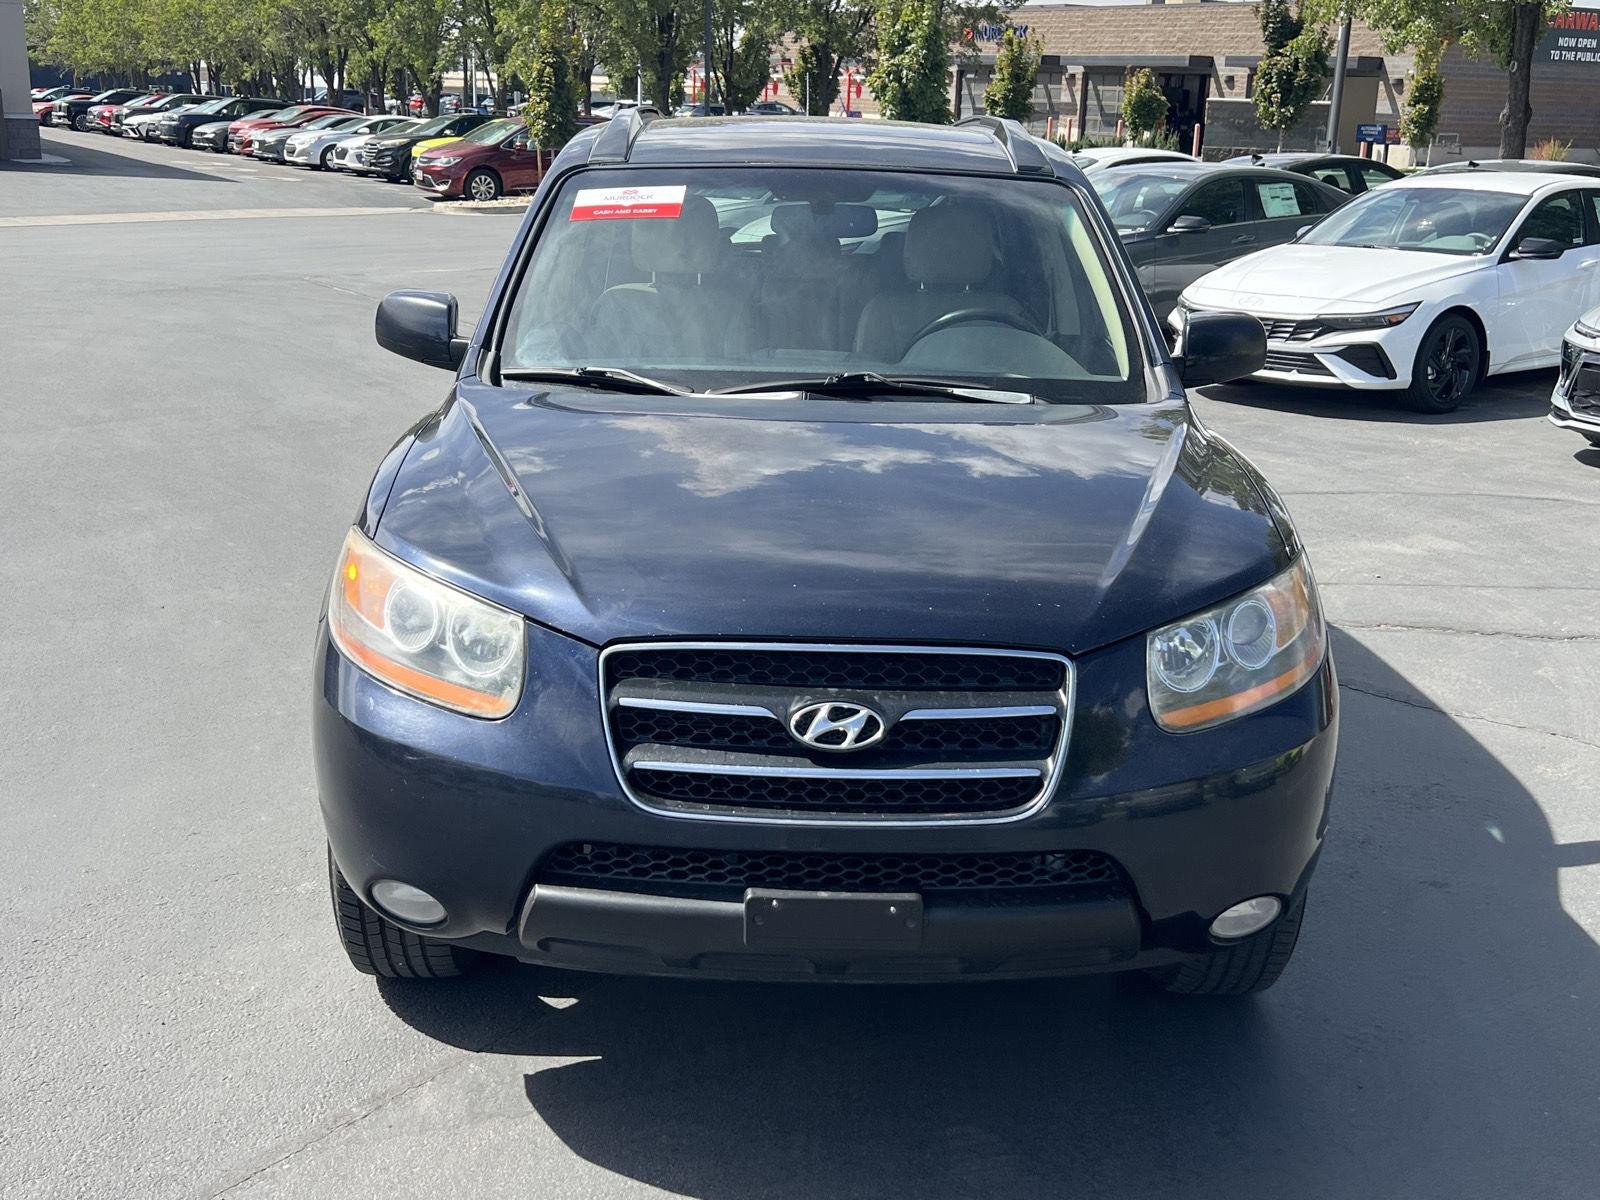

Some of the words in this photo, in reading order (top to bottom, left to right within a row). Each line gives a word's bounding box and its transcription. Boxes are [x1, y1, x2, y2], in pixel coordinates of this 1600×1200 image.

[1558, 37, 1577, 47] NOW
[1577, 38, 1597, 48] OPEN
[1550, 50, 1560, 60] TO
[1561, 51, 1576, 61] THE
[1576, 52, 1600, 62] PUBLIC
